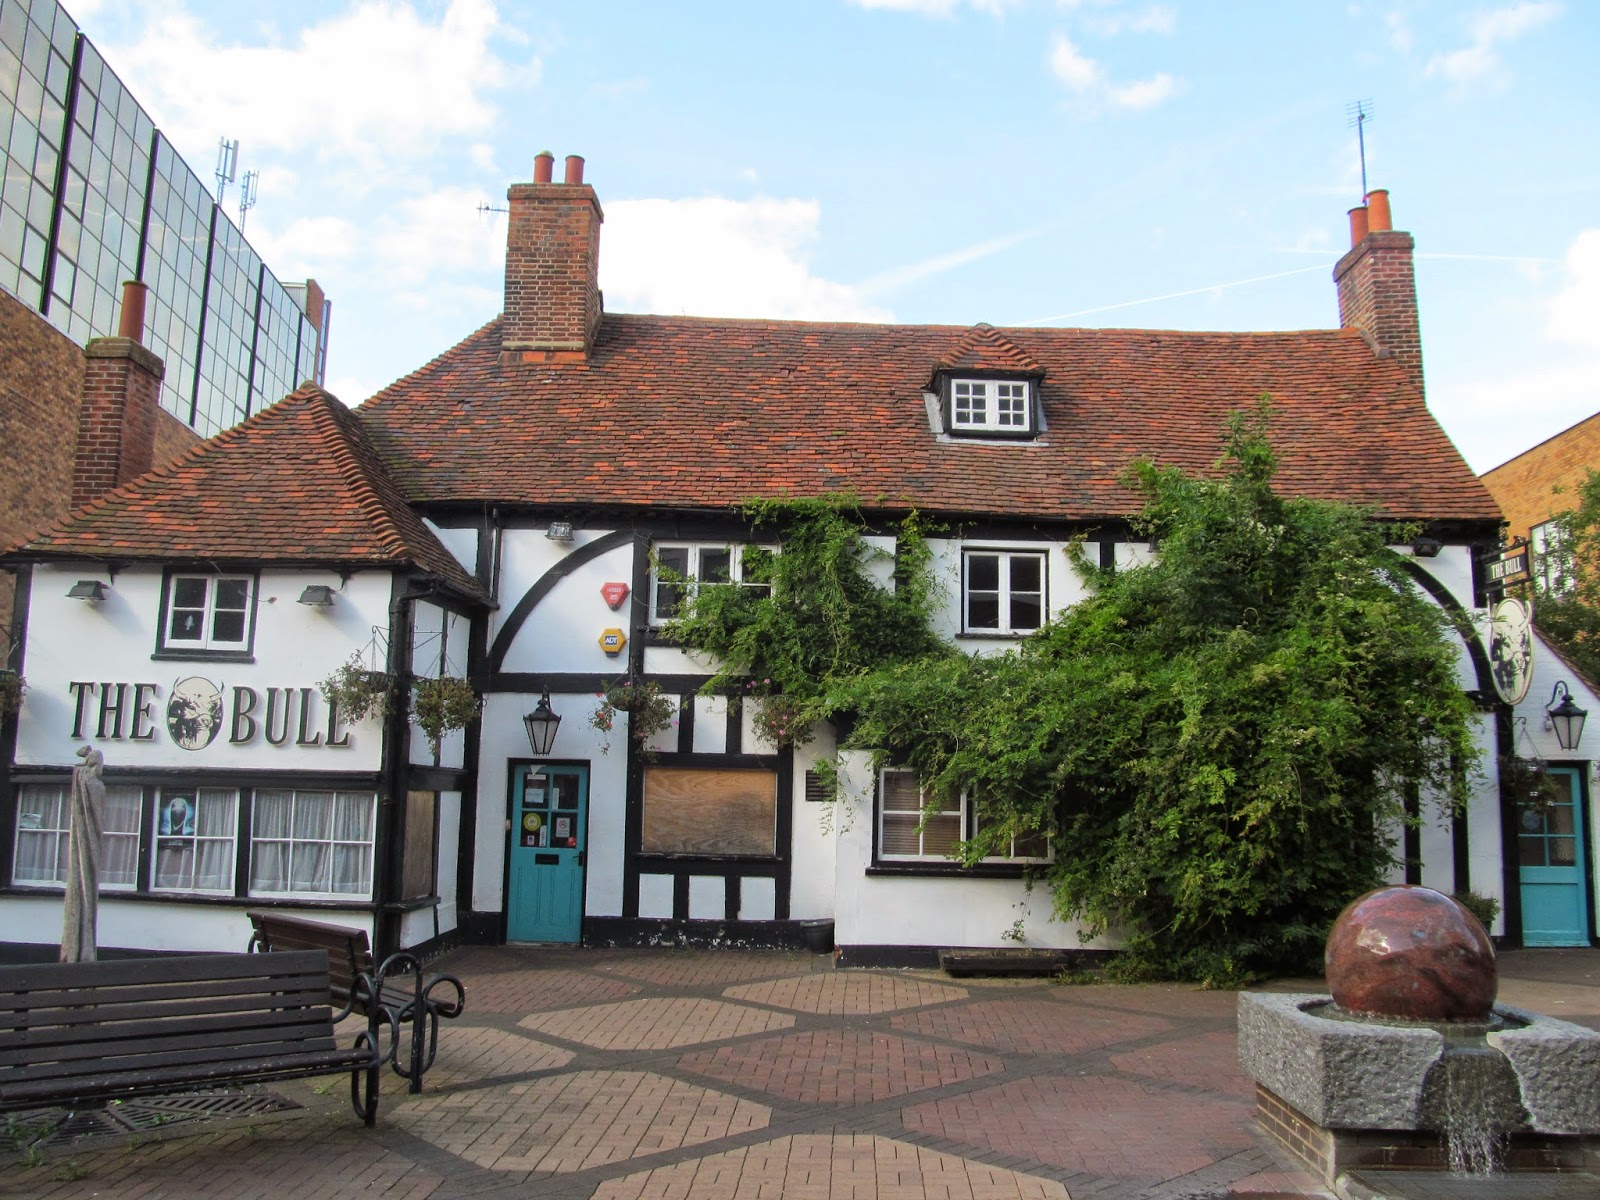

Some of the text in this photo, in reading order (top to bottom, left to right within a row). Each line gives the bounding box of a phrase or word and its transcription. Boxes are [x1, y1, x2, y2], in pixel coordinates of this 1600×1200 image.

[1491, 557, 1521, 579] THE BULL
[69, 681, 350, 746] THE BULL
